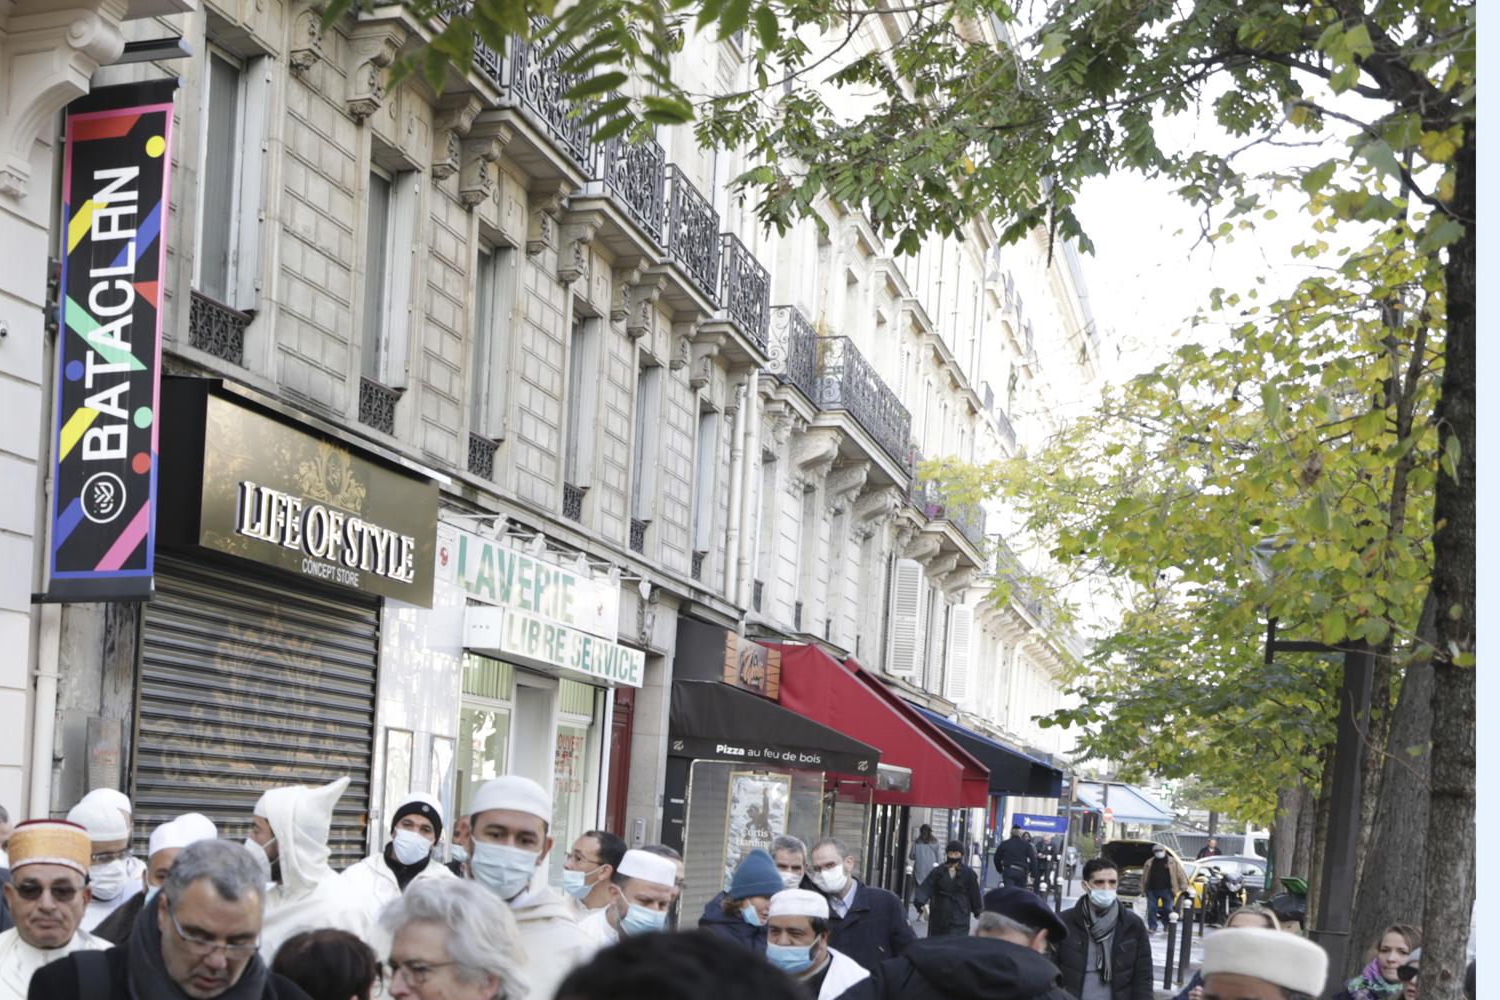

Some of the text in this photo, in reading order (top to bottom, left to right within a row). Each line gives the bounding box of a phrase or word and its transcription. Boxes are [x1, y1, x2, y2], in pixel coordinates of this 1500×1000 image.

[82, 165, 140, 461] BATACLAN
[238, 480, 416, 583] LIFE OF STYLE
[301, 558, 360, 588] CONCEPT STORE
[457, 534, 575, 624] LAVERIE
[506, 613, 640, 683] LIBRE SERVICE
[716, 744, 821, 764] Pizza au feu de bois
[735, 828, 771, 849] Curtis Harding
